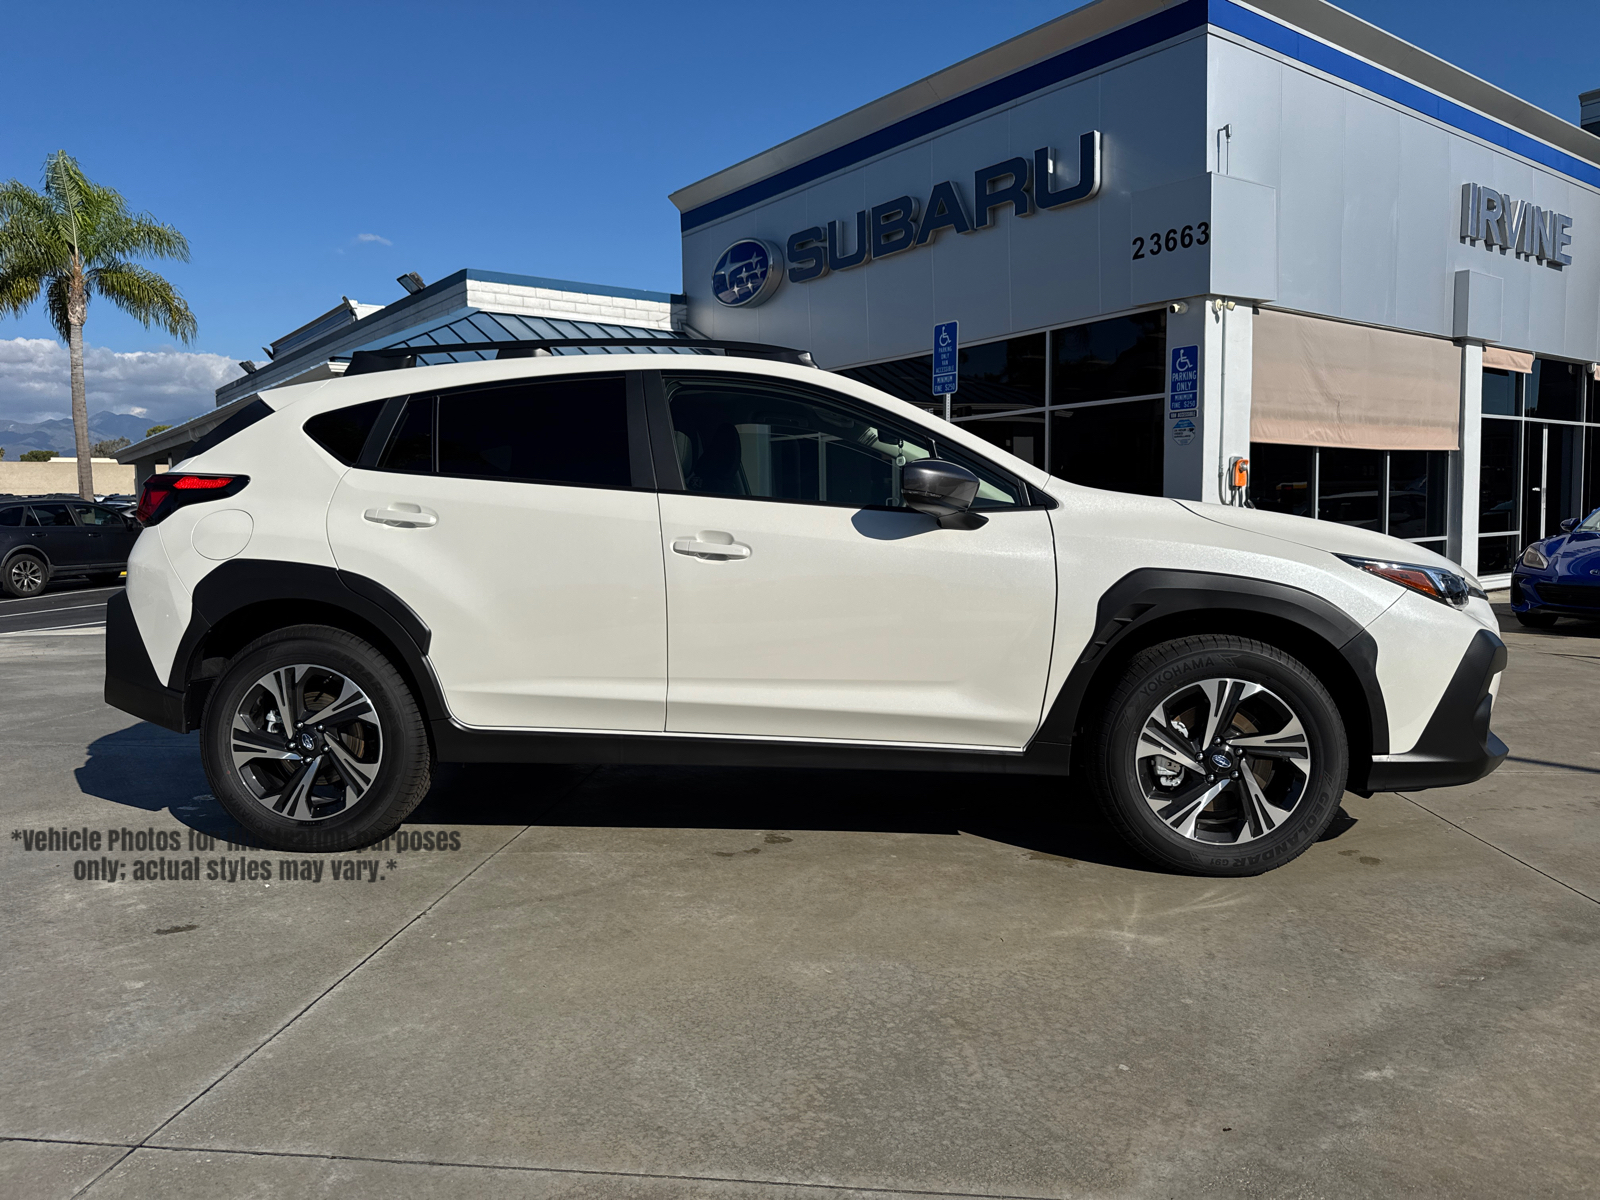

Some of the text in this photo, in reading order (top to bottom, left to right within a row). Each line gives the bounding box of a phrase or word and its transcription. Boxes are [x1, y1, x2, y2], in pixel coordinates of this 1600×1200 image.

[786, 129, 1101, 284] SUBARU
[1461, 182, 1573, 267] IRVINE
[1132, 221, 1209, 260] 23663
[935, 365, 955, 373] ACCESSIBLE
[936, 375, 953, 384] MINIMUM
[1172, 370, 1197, 381] PARKING
[944, 383, 955, 391] $250
[1176, 381, 1192, 391] ONLY
[1174, 393, 1193, 401] MINIMUM
[1183, 400, 1196, 408] $250
[1140, 656, 1215, 697] YOKOHAMA
[1210, 791, 1330, 868] GEOLANDAR G91
